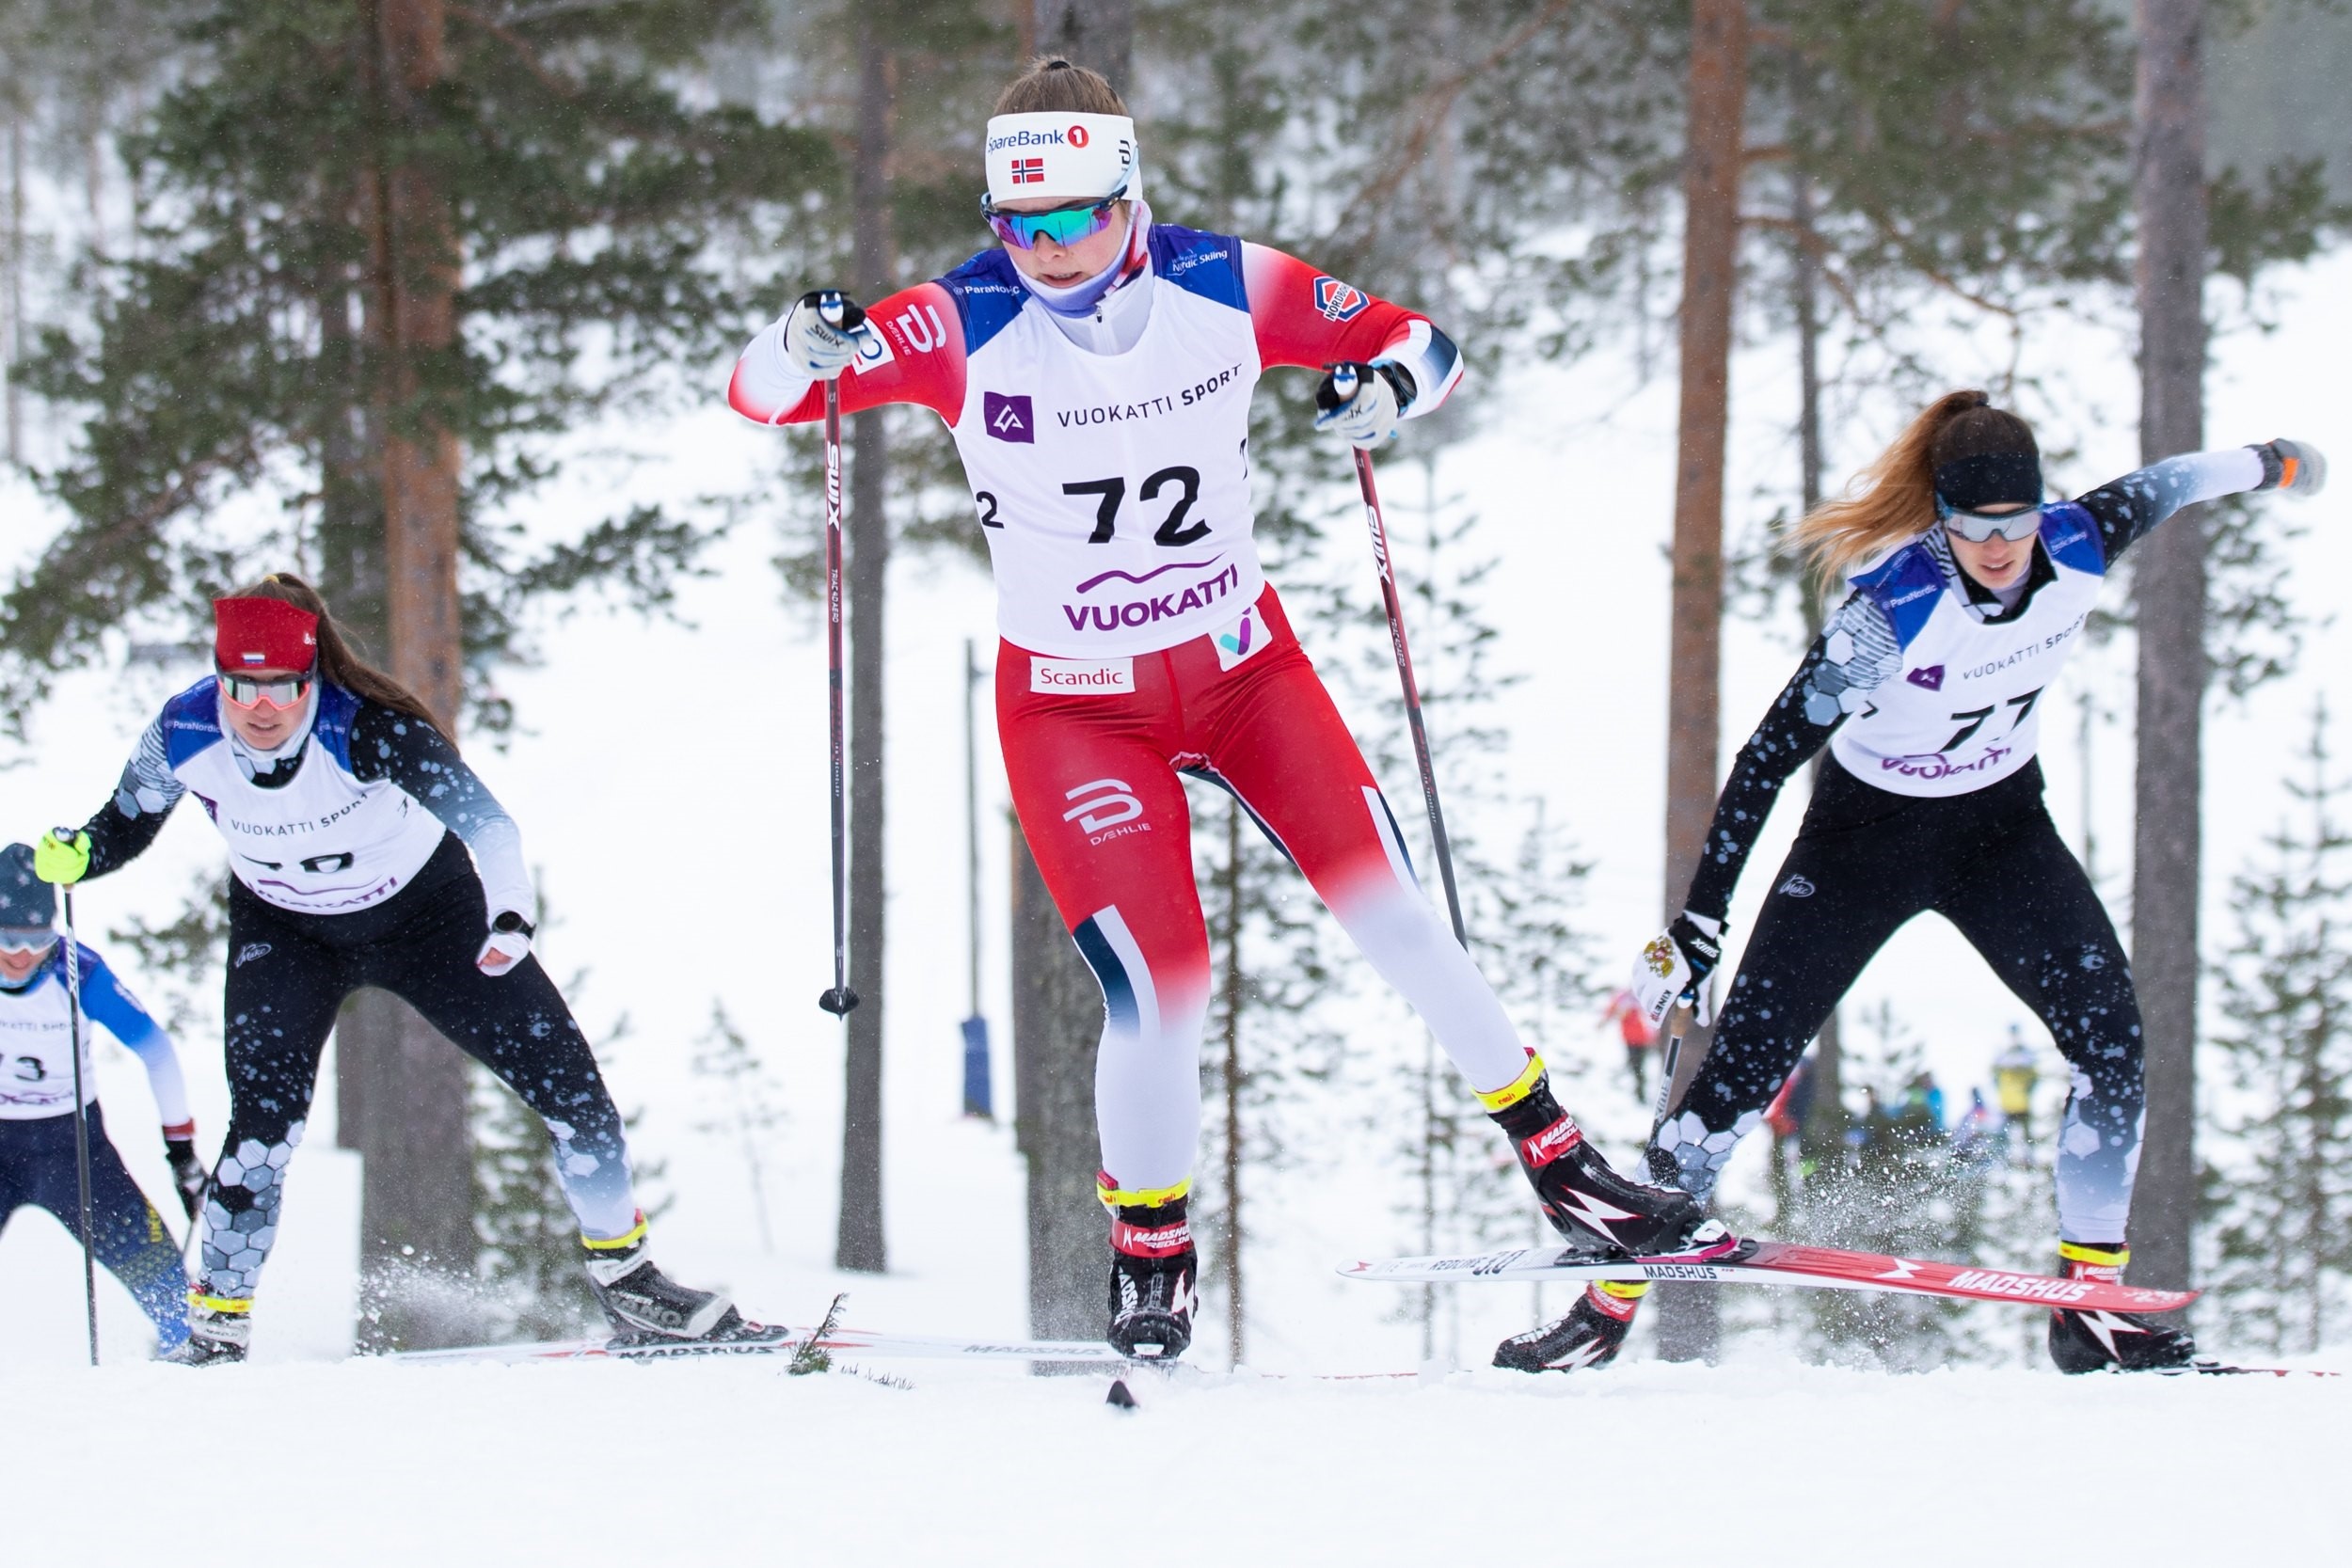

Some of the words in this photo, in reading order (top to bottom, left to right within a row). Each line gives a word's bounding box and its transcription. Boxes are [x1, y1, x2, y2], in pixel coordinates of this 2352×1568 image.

[1199, 249, 1228, 264] Skiing
[1057, 395, 1173, 428] VUOKATTI
[1181, 362, 1243, 406] SPORT
[1061, 465, 1213, 547] 72
[1062, 562, 1239, 632] VUOKATTI
[1963, 642, 2041, 681] VUOKATTI
[1040, 667, 1123, 686] Scandic
[230, 818, 315, 837] VUOKATTI
[1540, 1117, 1576, 1149] MADS
[1132, 1224, 1190, 1242] MADSHU
[1143, 1234, 1191, 1249] REDLIN
[1643, 1265, 1718, 1280] MADSHUS
[1947, 1270, 2097, 1303] MADSHUS
[618, 1345, 775, 1360] MADSHUS
